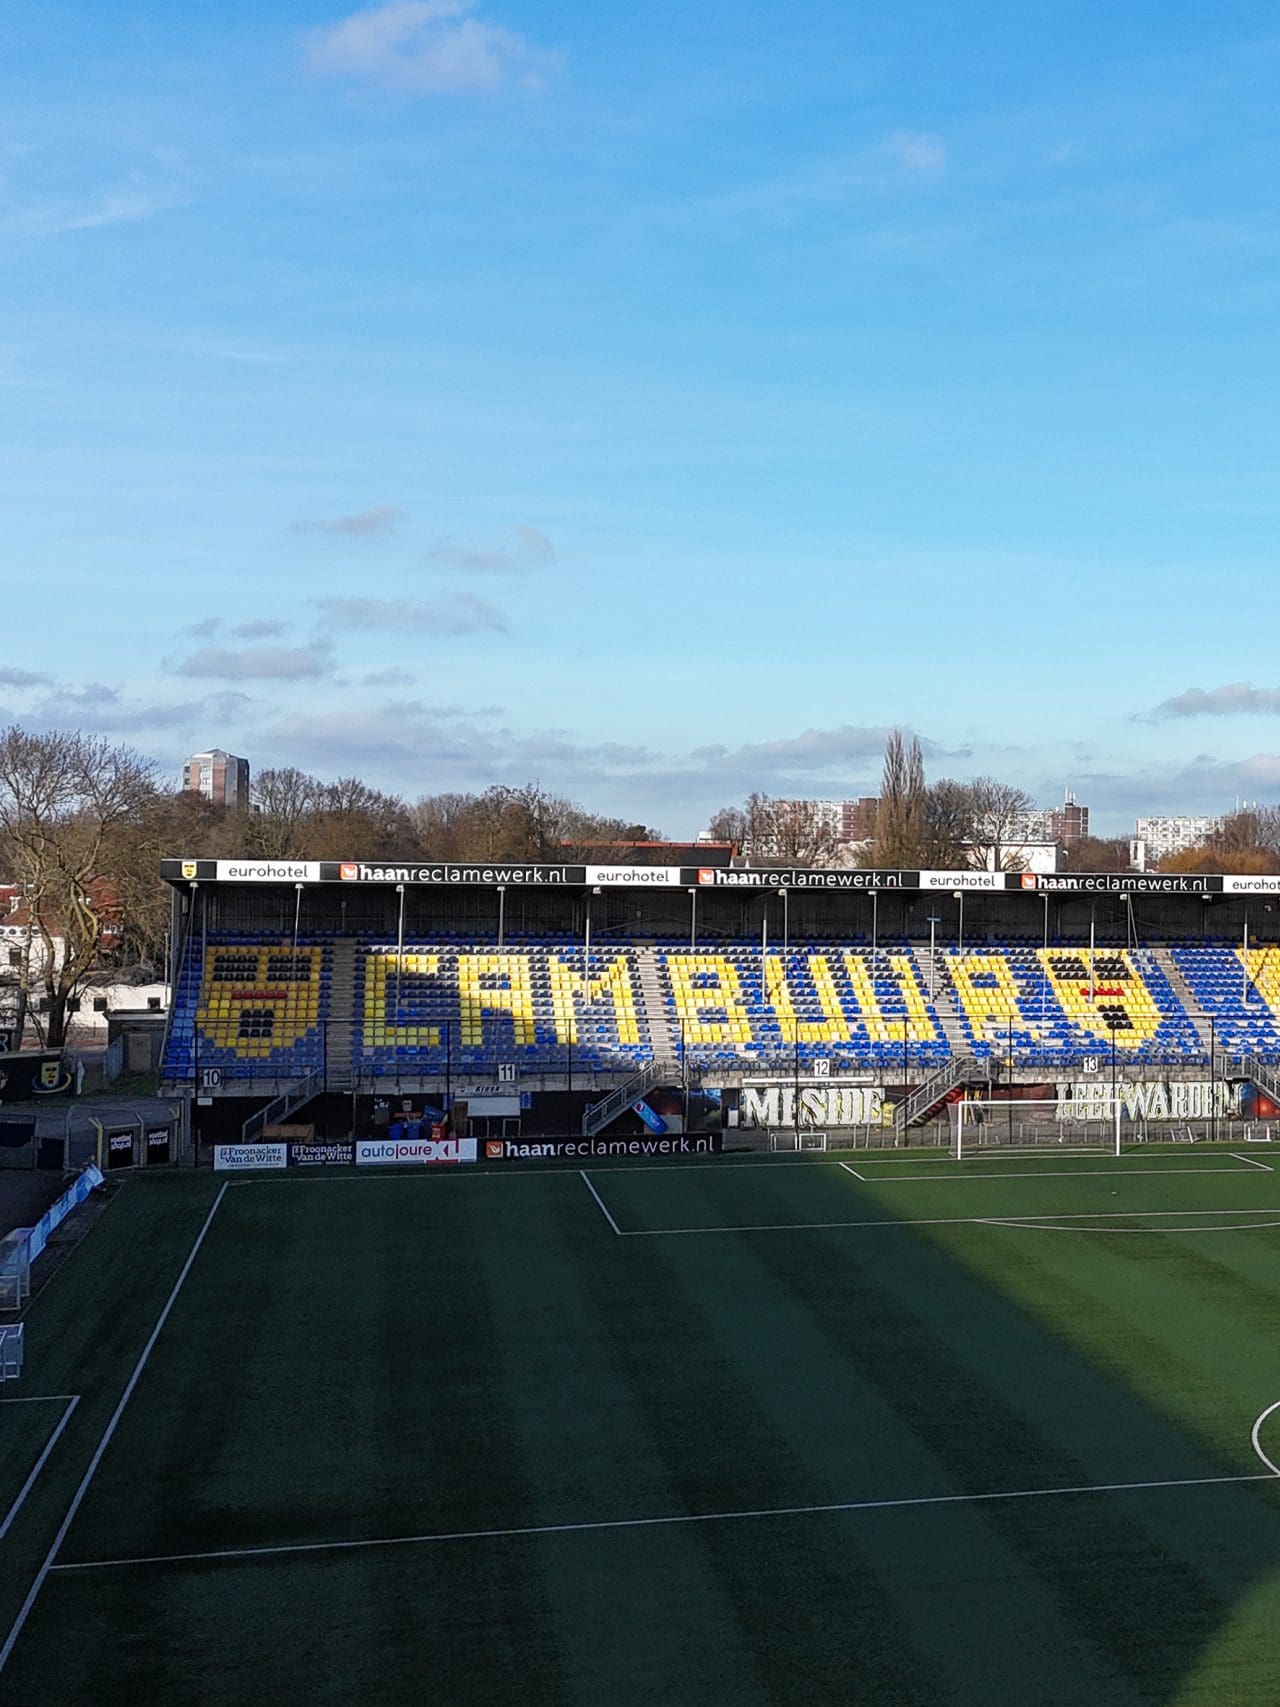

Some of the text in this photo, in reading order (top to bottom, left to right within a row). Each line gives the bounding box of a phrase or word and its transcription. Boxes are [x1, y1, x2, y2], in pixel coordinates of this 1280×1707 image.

[228, 865, 308, 878] eurohotel
[357, 864, 567, 884] haanreclamewerk.nl
[596, 869, 670, 883] eurohotel
[714, 869, 903, 887] haanreclamewerk.nl
[929, 874, 996, 887] eurohotel
[1037, 874, 1208, 891] haanreclamewerk.nl
[501, 1065, 515, 1080] 11
[815, 1060, 829, 1076] 12
[1084, 1057, 1098, 1072] 13
[204, 1069, 220, 1086] 10
[1055, 1081, 1242, 1121] LEEUWARDEN
[361, 1143, 432, 1159] autojoure
[505, 1134, 714, 1157] haanreclamewerk.nl
[255, 1153, 282, 1162] Witte
[325, 1151, 352, 1160] Witte
